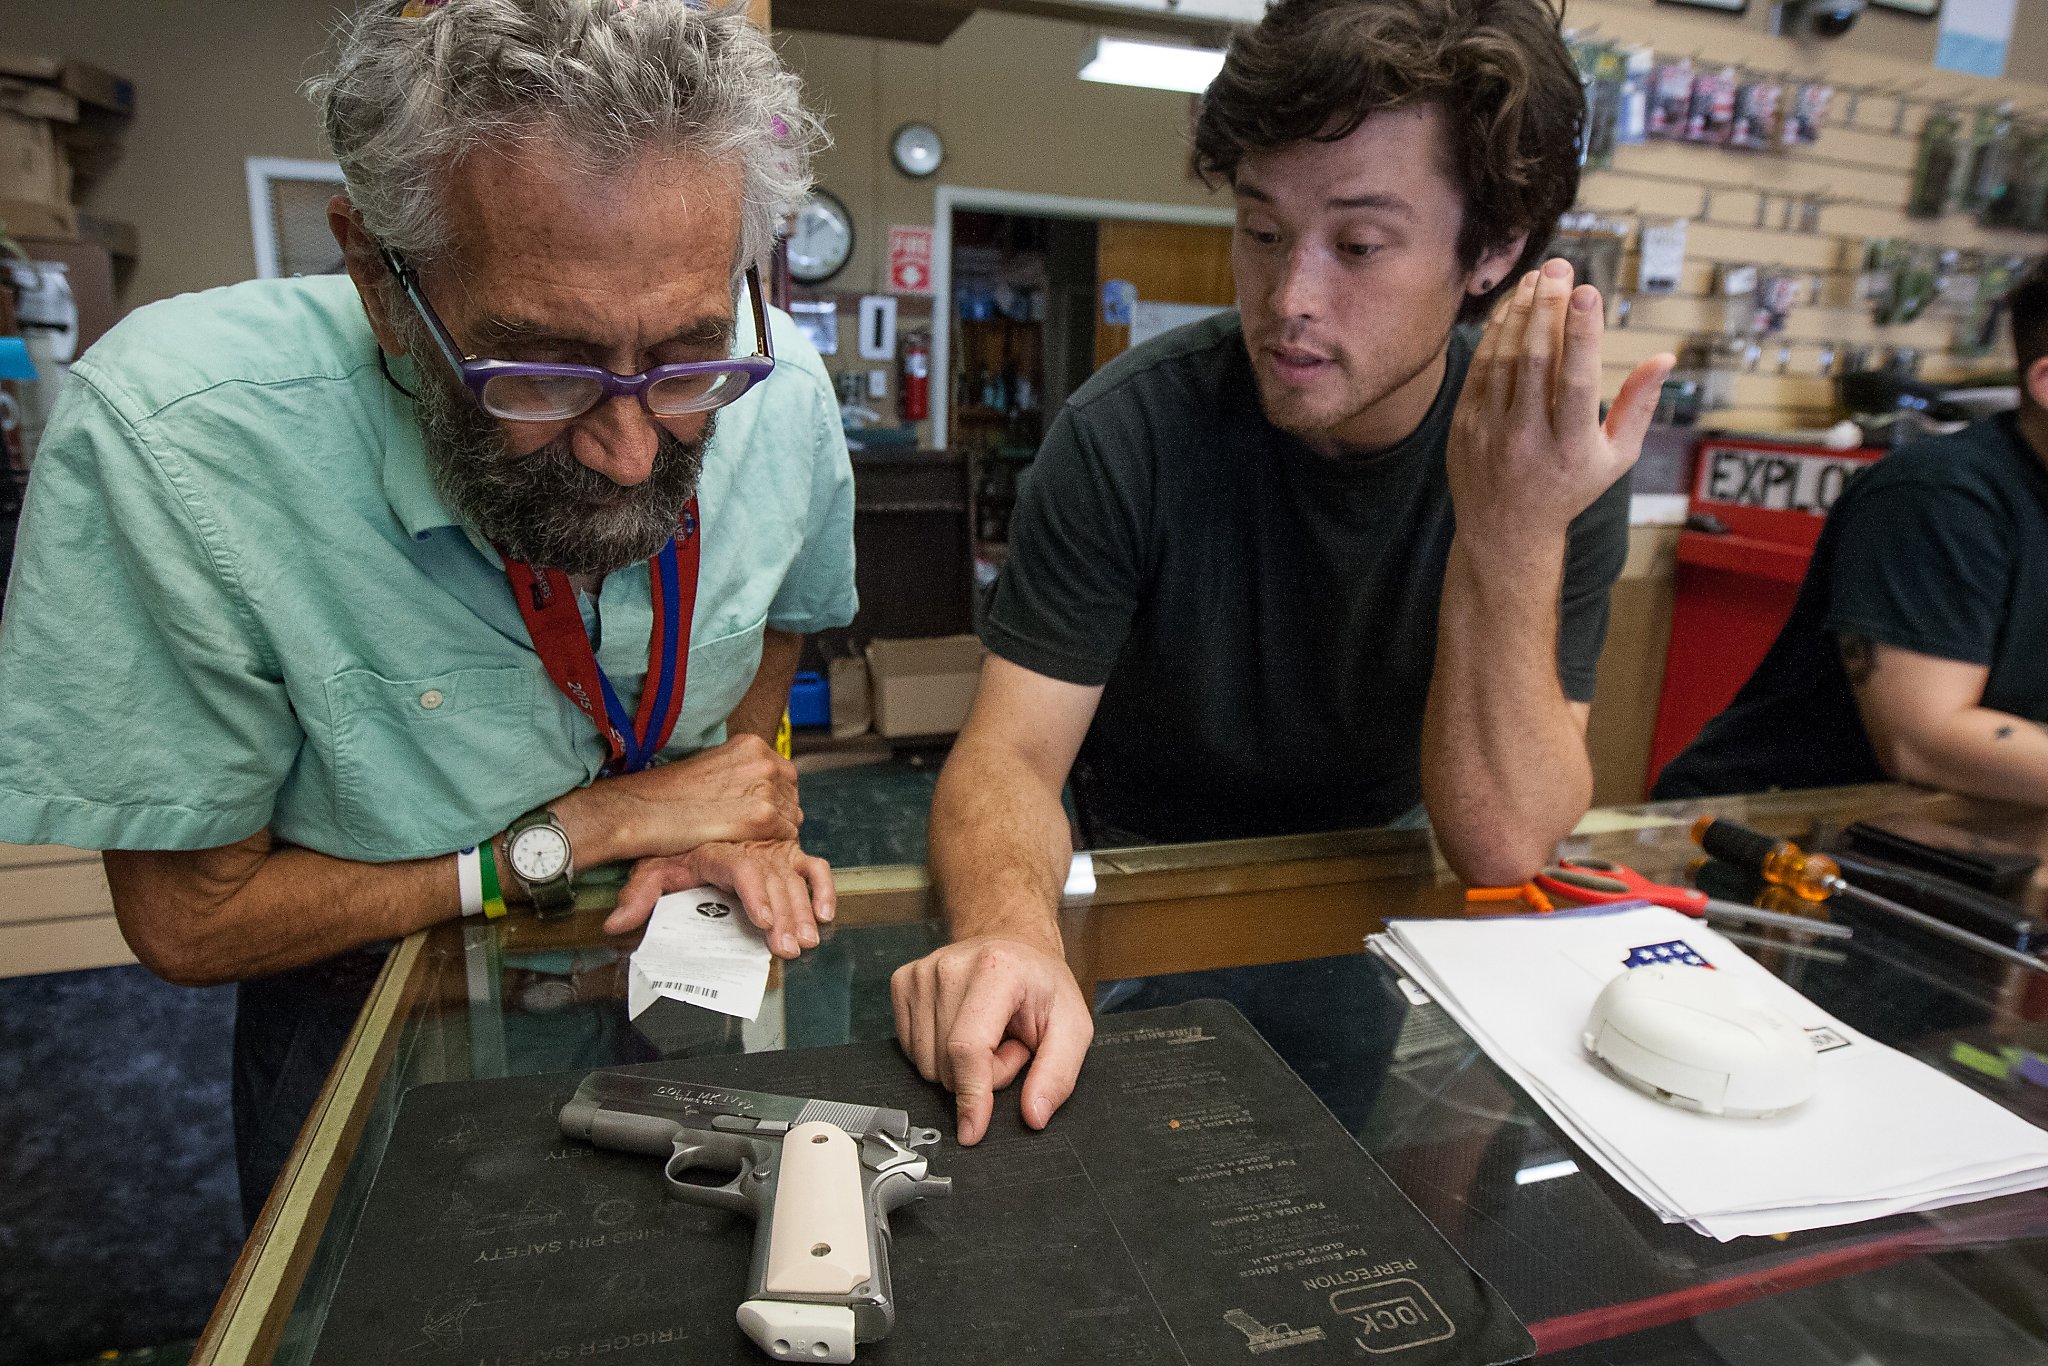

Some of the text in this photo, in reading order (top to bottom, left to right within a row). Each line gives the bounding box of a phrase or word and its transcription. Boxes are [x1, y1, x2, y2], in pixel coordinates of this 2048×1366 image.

[567, 682, 593, 711] 2015
[657, 1086, 695, 1097] COLT
[698, 1092, 721, 1101] MK
[1276, 1158, 1297, 1167] For
[1274, 1206, 1303, 1217] USA
[1305, 1201, 1326, 1211] For
[1211, 1213, 1260, 1227] Canada
[569, 1235, 605, 1250] PIN
[1307, 1241, 1345, 1255] GLOCK
[473, 1240, 562, 1263] SAFETY
[1345, 1247, 1368, 1257] For
[1297, 1252, 1343, 1267] Europe
[1239, 1264, 1279, 1278] Africa
[1302, 1258, 1418, 1291] PERFECTION
[580, 1327, 689, 1356] TRIGGER
